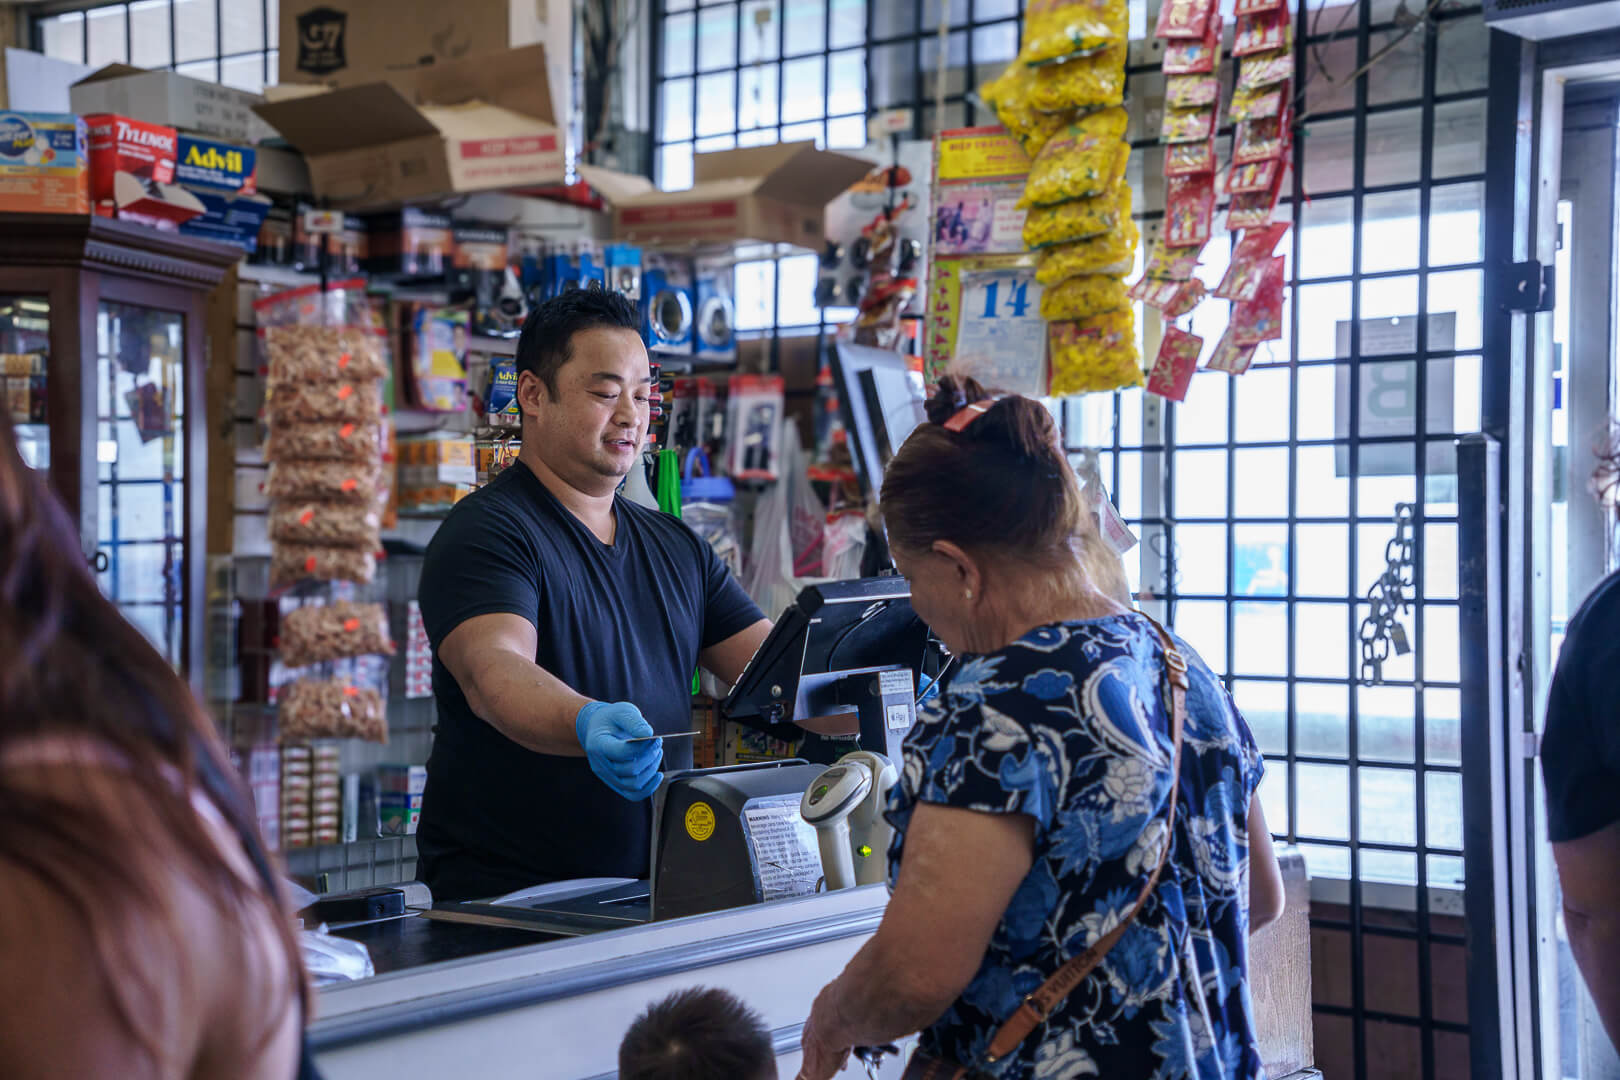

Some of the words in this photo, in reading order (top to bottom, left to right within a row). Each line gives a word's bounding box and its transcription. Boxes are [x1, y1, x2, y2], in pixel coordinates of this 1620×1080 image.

[304, 23, 340, 48] G7
[116, 121, 174, 151] TYLENOL
[185, 145, 243, 174] Advil
[978, 279, 1032, 318] 14
[498, 371, 518, 381] Advi
